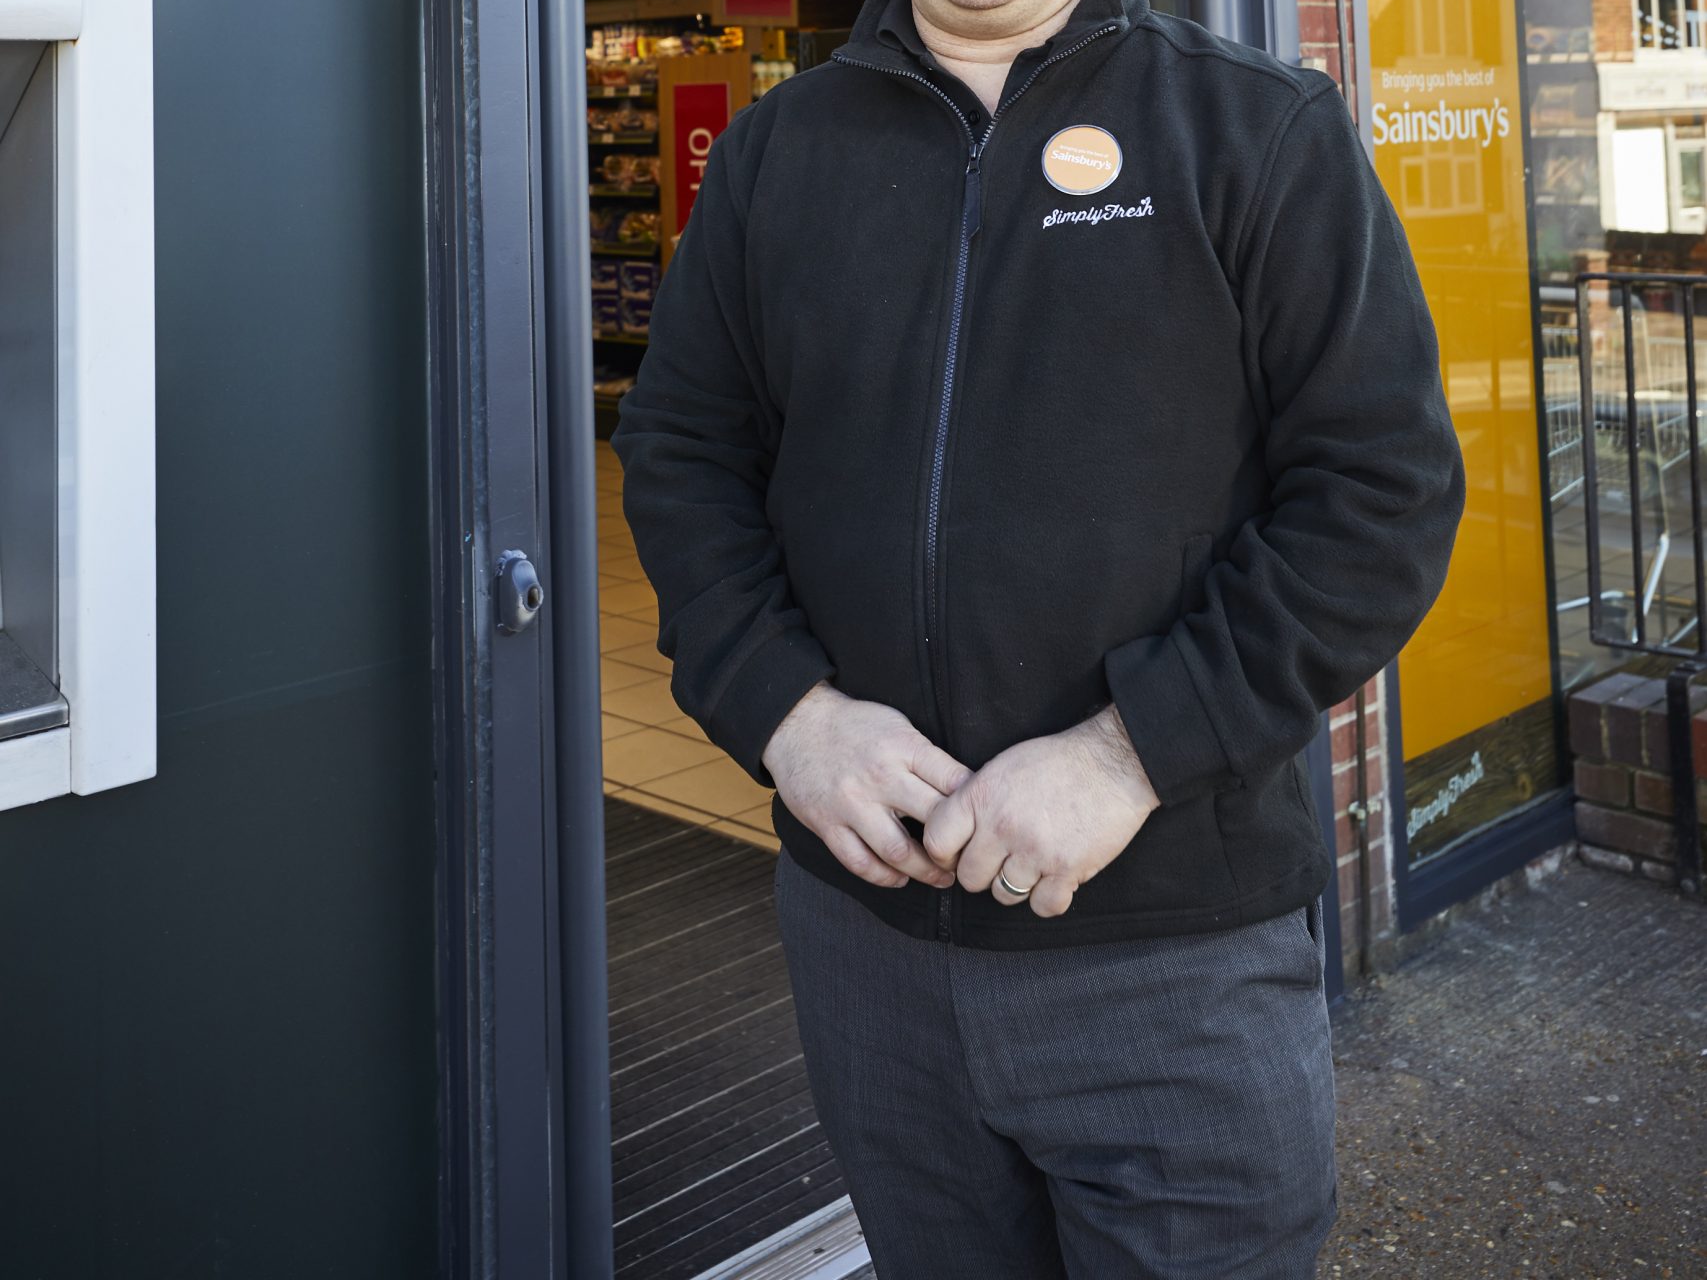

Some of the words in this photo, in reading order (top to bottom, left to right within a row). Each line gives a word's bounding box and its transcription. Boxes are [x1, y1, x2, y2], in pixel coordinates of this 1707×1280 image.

[1382, 70, 1425, 93] Bringing
[1426, 73, 1445, 92] you
[1446, 69, 1462, 87] the
[1463, 68, 1484, 87] best
[1484, 67, 1495, 86] of
[1372, 98, 1510, 148] Sainsbury's
[1050, 150, 1112, 171] Sainsbury's
